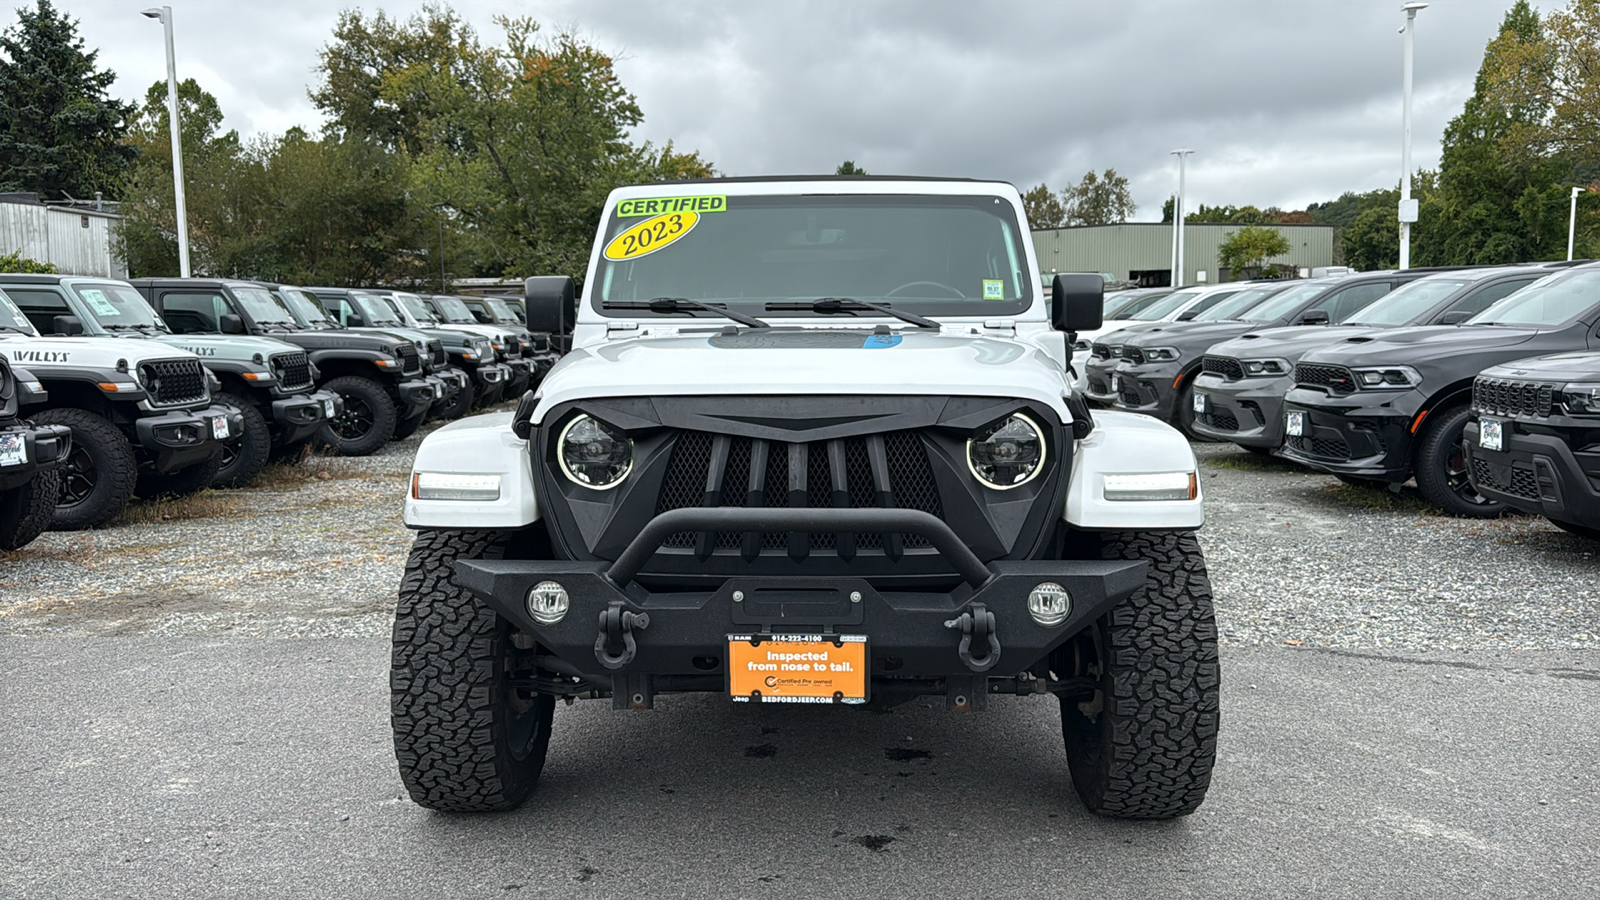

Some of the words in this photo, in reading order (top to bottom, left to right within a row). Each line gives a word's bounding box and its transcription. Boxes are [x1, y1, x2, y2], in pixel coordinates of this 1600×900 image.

[620, 197, 723, 215] CERTIFIED
[622, 214, 684, 257] 2023
[13, 350, 70, 362] WILLYS
[180, 346, 217, 356] LYS
[767, 651, 828, 663] Inspected
[747, 661, 778, 671] from
[780, 663, 810, 671] nose
[813, 662, 827, 671] to
[829, 662, 854, 672] tail.
